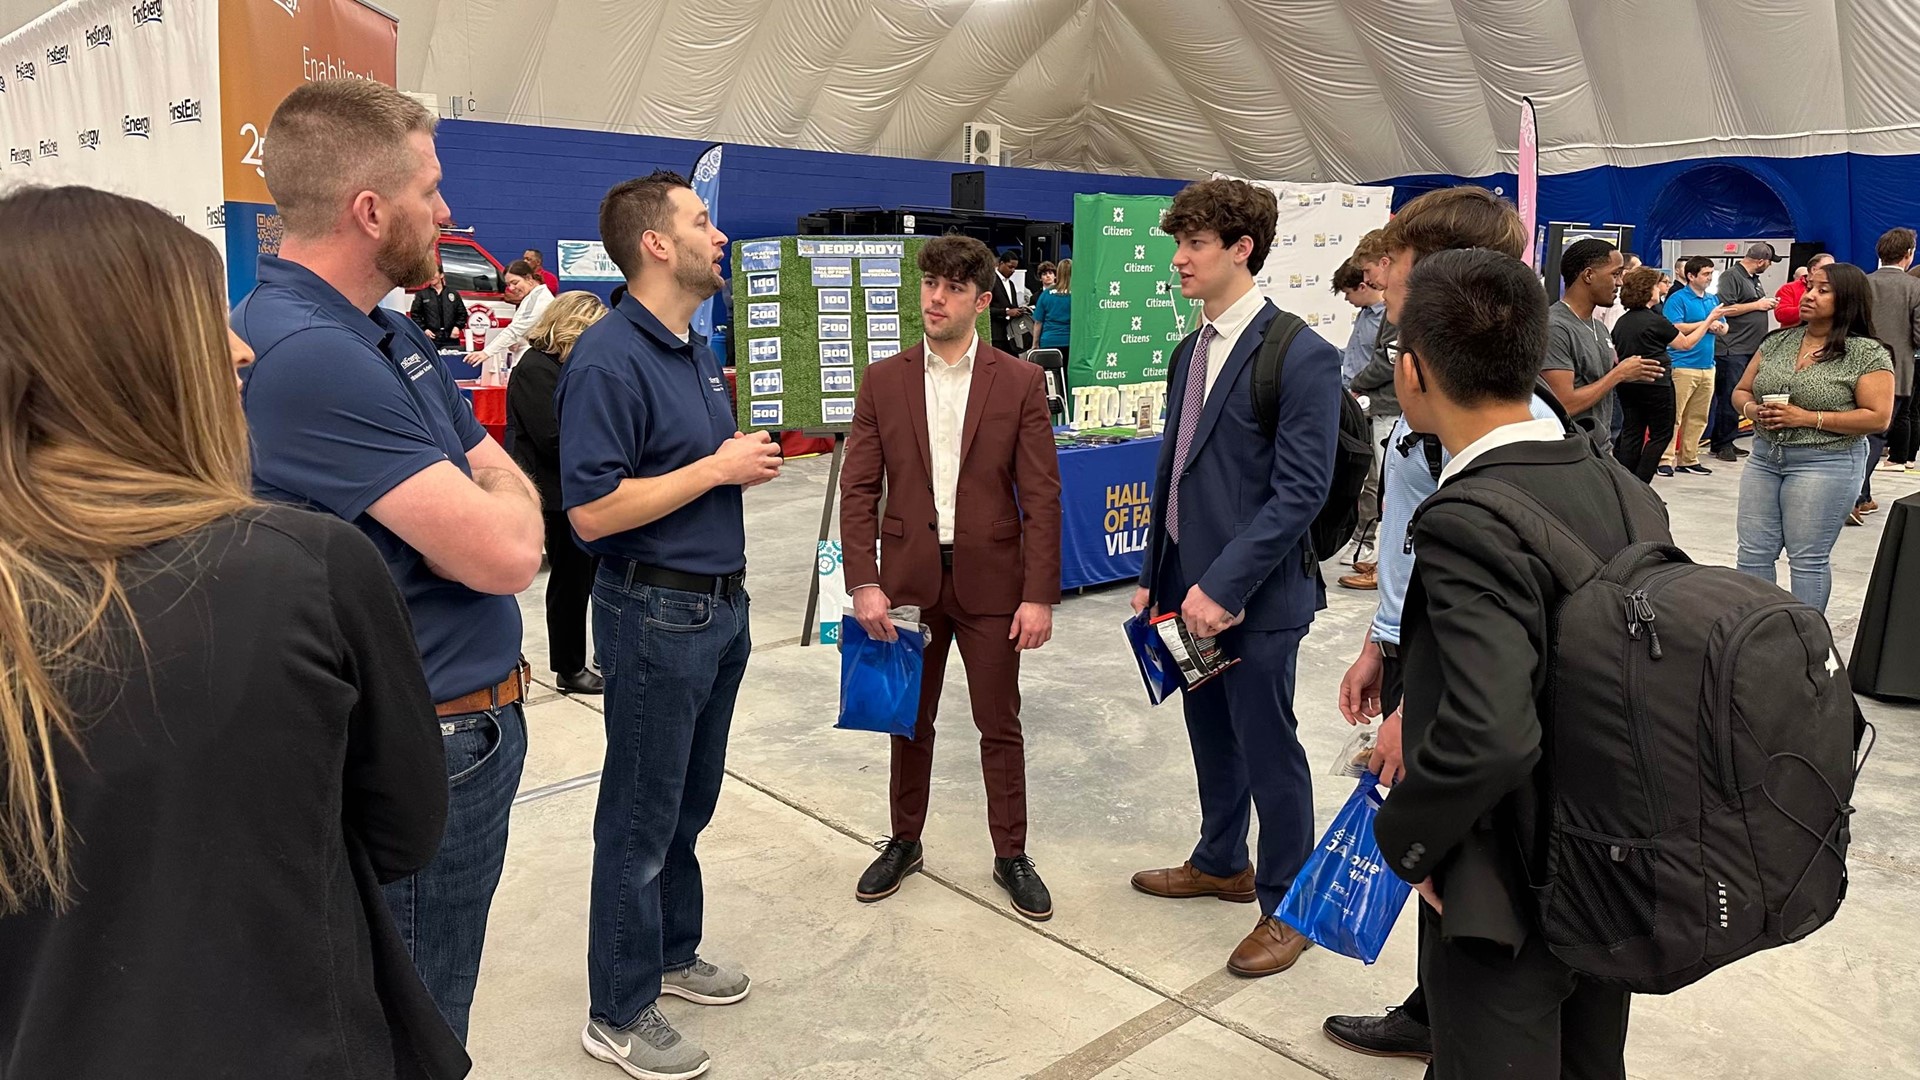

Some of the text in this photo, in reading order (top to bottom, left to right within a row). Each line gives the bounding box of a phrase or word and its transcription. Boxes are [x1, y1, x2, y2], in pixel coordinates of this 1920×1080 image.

[1102, 225, 1133, 237] Citizens
[1149, 226, 1173, 237] Citiz
[817, 244, 902, 255] JEOPARDY!
[594, 260, 620, 271] TWIS
[1124, 262, 1154, 273] Citizens
[752, 279, 774, 288] 100
[823, 295, 846, 304] 100
[870, 295, 892, 304] 100
[1099, 299, 1129, 309] Citizens
[751, 310, 776, 319] 200
[821, 323, 847, 332] 200
[870, 322, 896, 331] 200
[1121, 333, 1150, 344] Citizens
[1166, 332, 1187, 342] Citiz
[752, 345, 776, 354] 300
[823, 349, 848, 358] 300
[872, 349, 897, 358] 300
[1096, 370, 1126, 380] Citizens
[1143, 367, 1168, 377] Citizen
[754, 377, 779, 387] 400
[825, 375, 851, 385] 400
[753, 409, 777, 419] 500
[826, 406, 852, 415] 500
[1106, 481, 1149, 509] HALL
[1104, 504, 1151, 533] OF FA
[1105, 527, 1148, 556] VILLA
[1717, 881, 1728, 928] JESTER
